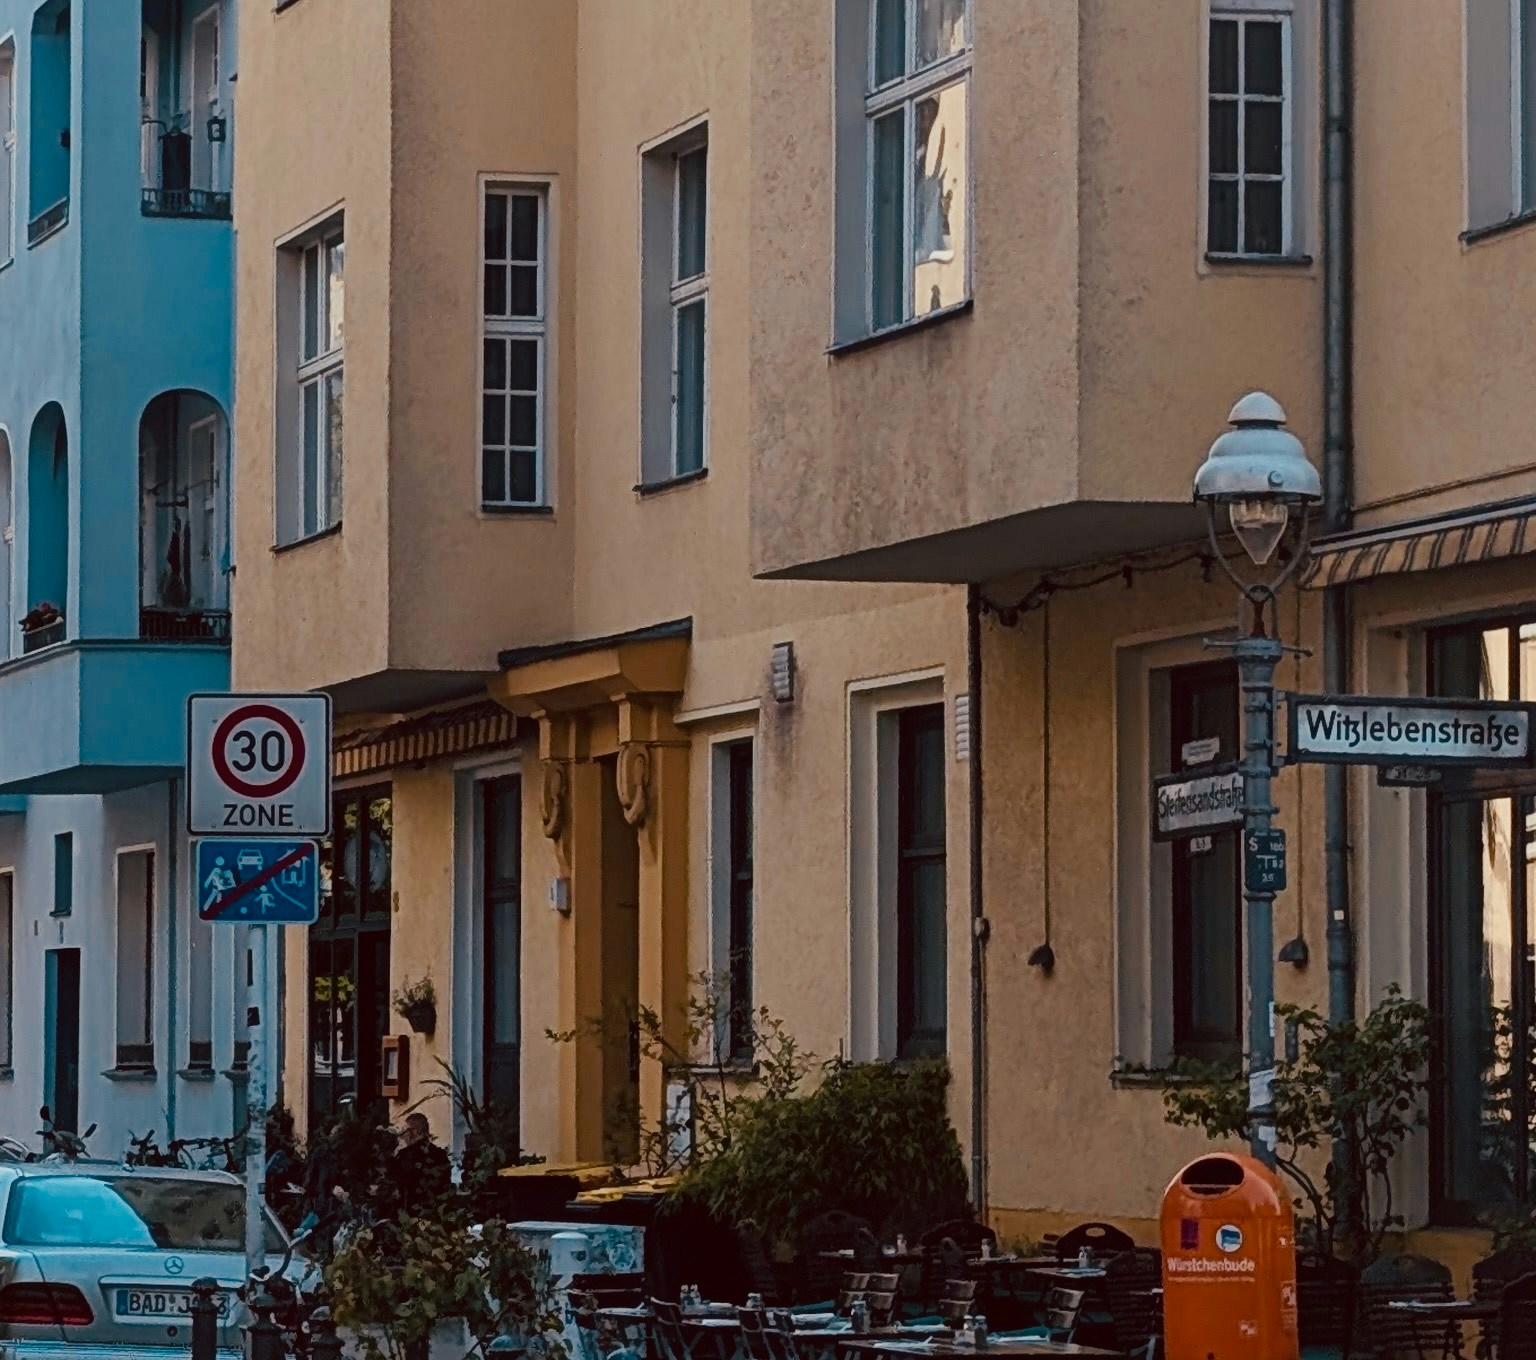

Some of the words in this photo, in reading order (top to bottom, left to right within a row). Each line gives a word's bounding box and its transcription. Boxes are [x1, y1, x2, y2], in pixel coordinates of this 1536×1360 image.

[232, 730, 285, 773] 30
[223, 803, 294, 827] ZONE
[129, 1293, 166, 1313] BAD
